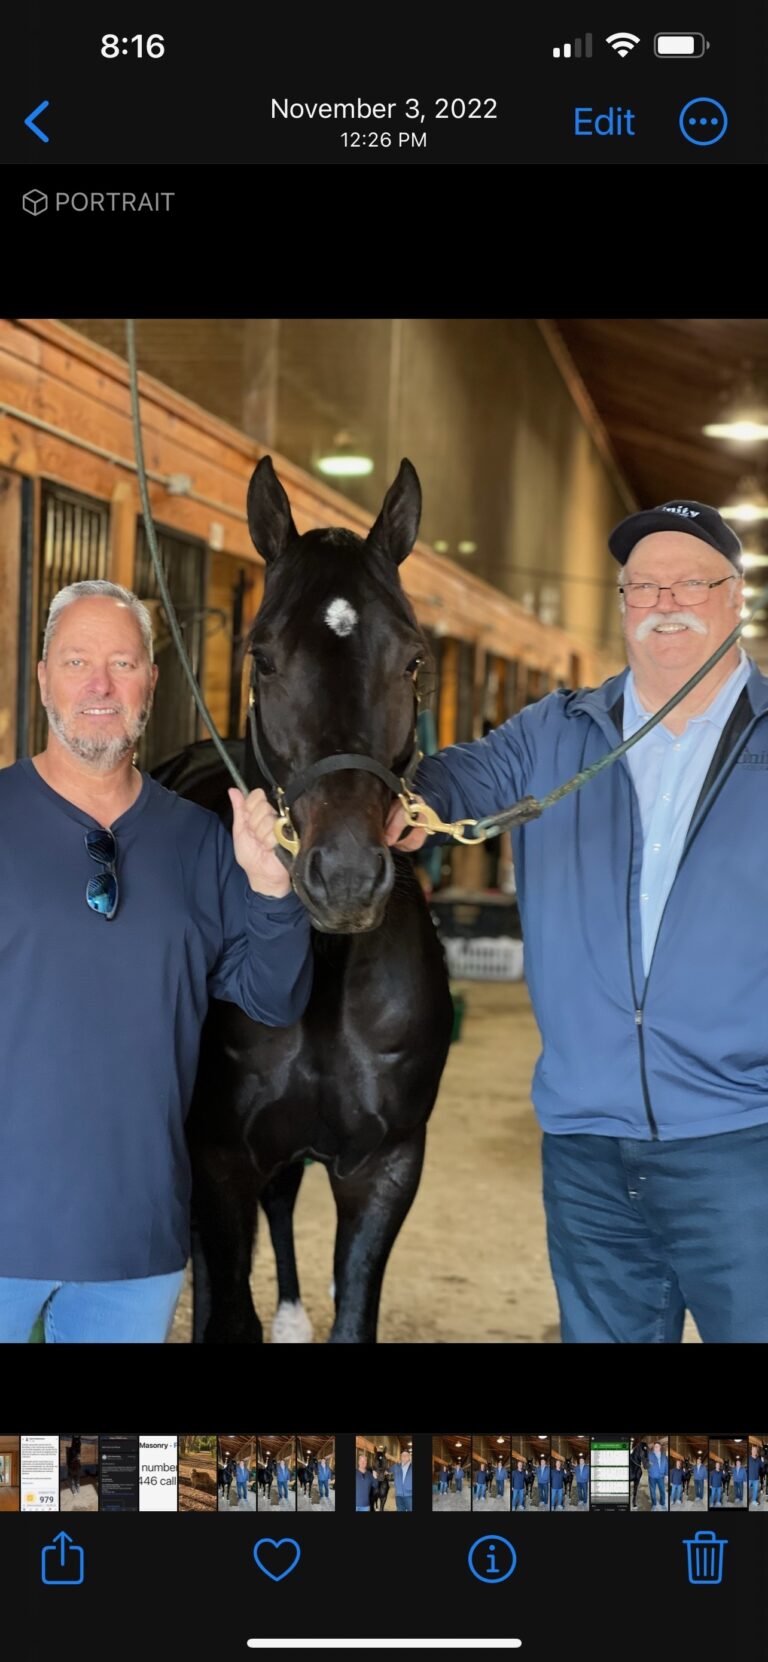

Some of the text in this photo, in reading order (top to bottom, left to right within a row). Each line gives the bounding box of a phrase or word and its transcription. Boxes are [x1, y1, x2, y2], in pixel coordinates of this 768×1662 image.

[100, 33, 165, 59] 8:16
[271, 97, 498, 123] November 3, 2022
[574, 107, 636, 136] Edit
[340, 131, 427, 148] 12:26 PM
[56, 191, 176, 212] PORTRAIT
[662, 505, 701, 518] nity
[39, 1495, 54, 1504] 979
